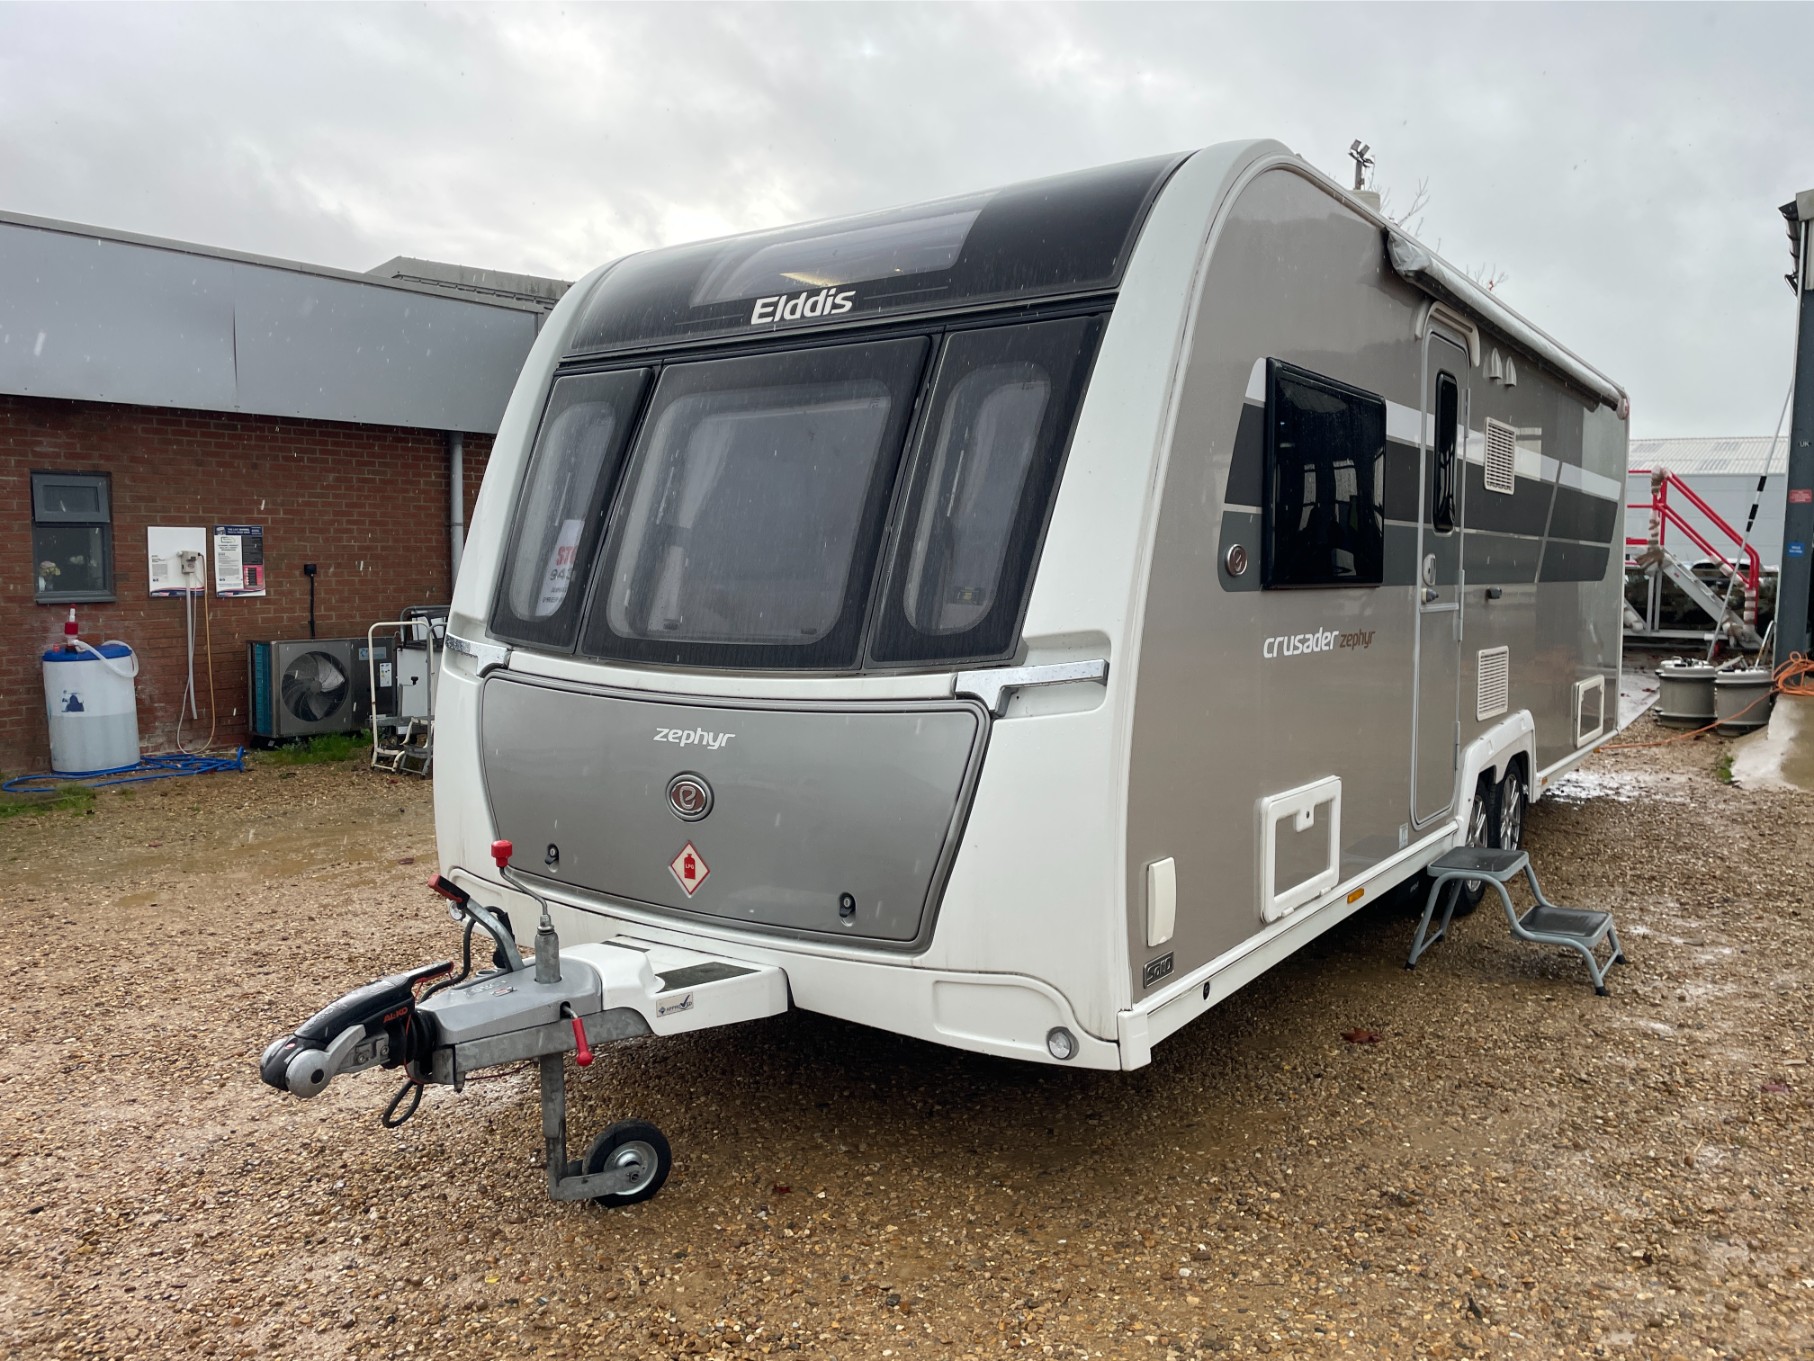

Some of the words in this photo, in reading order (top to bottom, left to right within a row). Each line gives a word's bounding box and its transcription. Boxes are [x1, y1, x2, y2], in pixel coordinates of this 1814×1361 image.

[751, 288, 856, 325] Elddis
[1263, 627, 1339, 658] crusader
[1340, 628, 1376, 651] zephyr
[653, 727, 736, 750] zephyr
